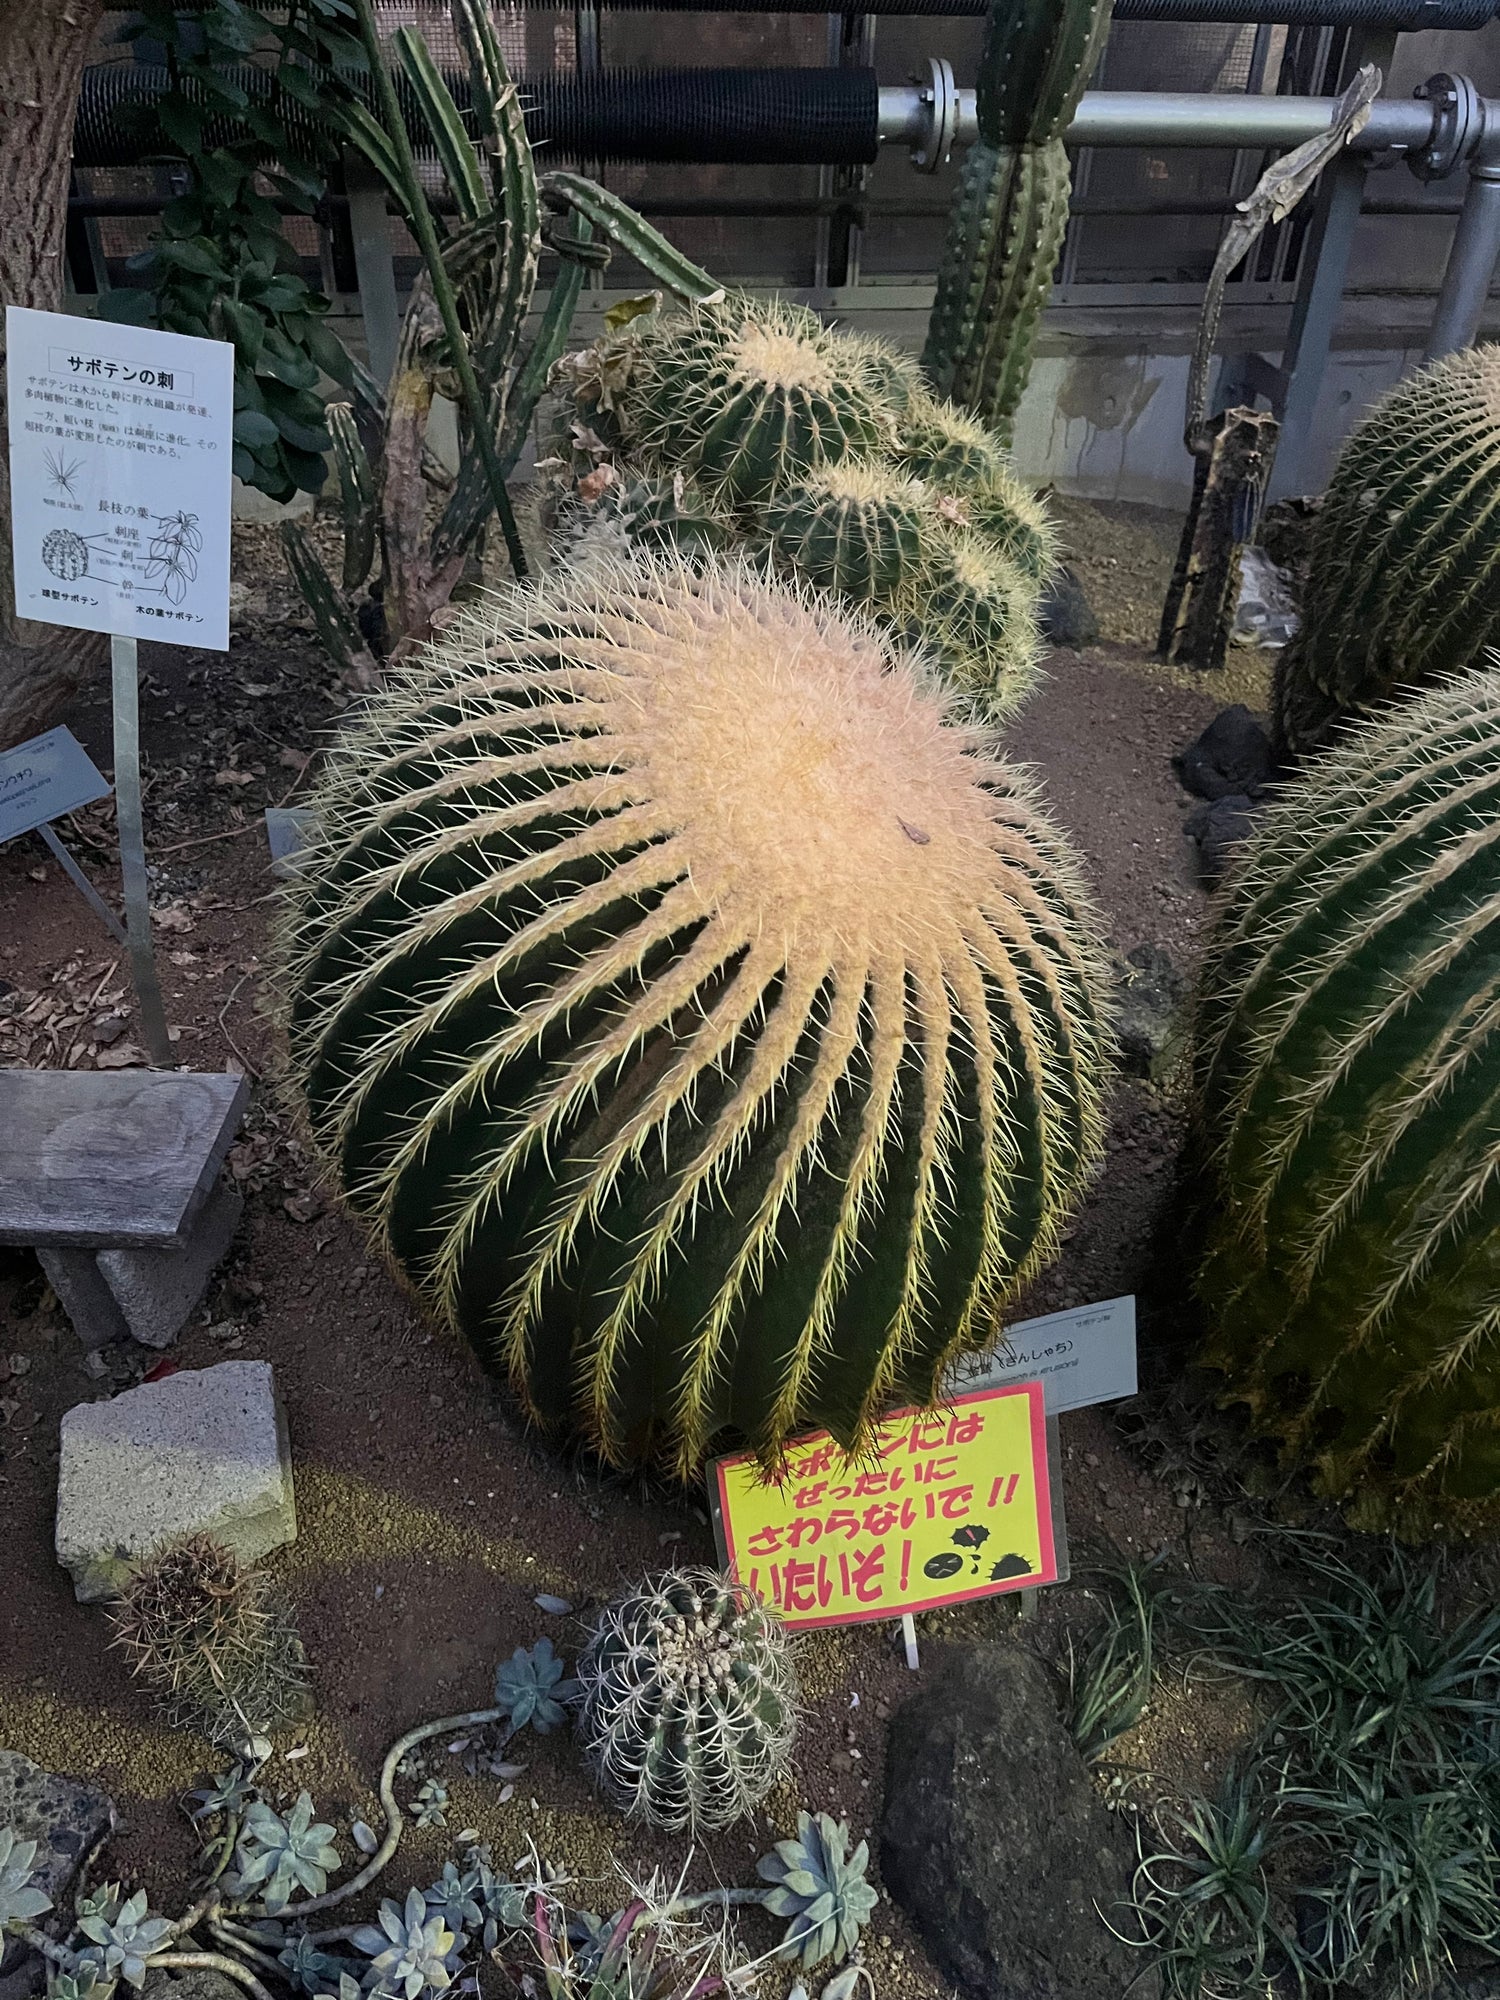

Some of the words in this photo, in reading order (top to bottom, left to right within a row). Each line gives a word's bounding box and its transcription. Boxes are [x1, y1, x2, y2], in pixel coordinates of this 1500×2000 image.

[67, 355, 174, 391] サボテンの刺
[98, 499, 150, 520] 長枝の葉
[135, 605, 204, 624] 木の葉サボテン
[972, 1340, 1074, 1377] （きんしゃち）
[760, 1412, 985, 1488] ボンには
[793, 1455, 959, 1510] ぜったいに
